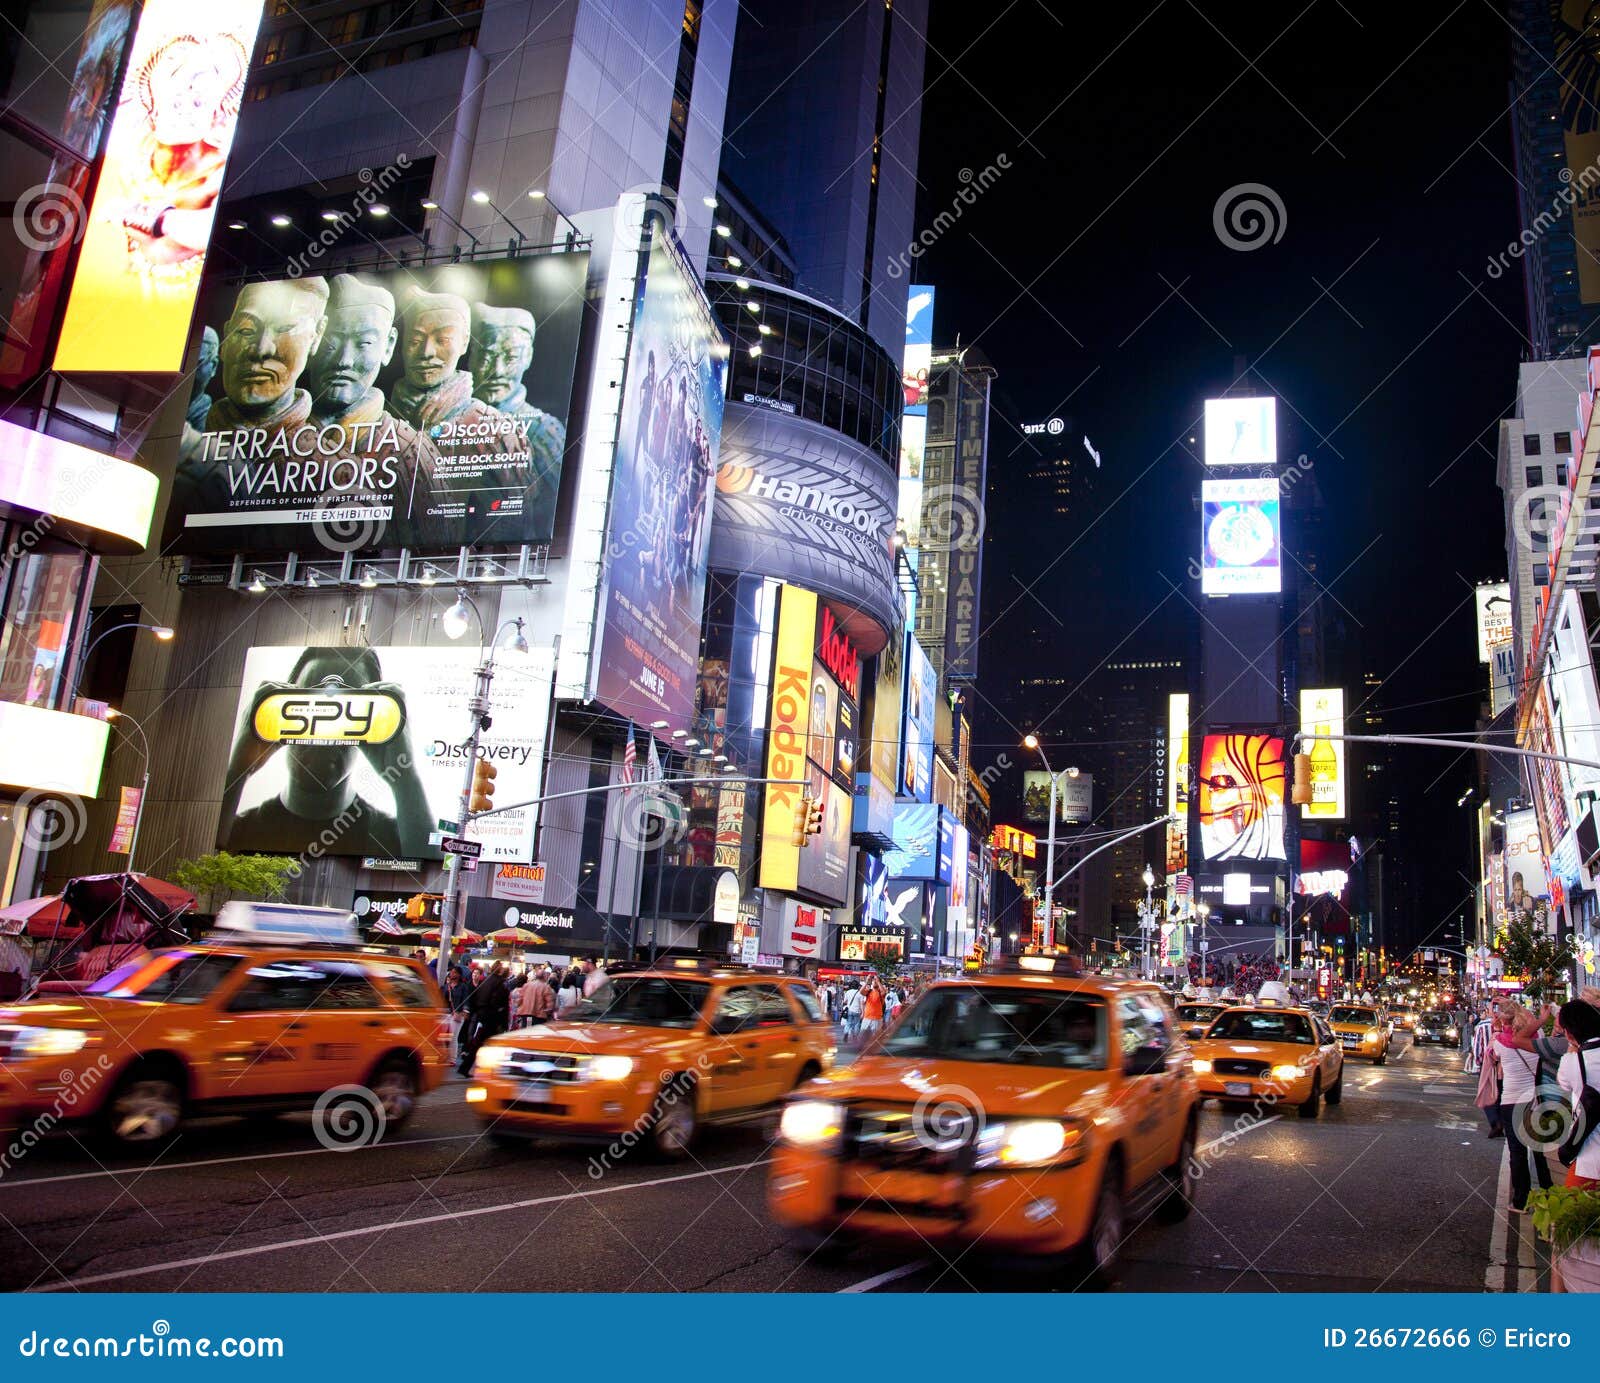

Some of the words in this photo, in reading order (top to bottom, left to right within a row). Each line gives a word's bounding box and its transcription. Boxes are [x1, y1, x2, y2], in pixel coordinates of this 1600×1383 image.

[438, 420, 532, 438] Discovery
[201, 420, 401, 462] TERRACOTTA
[437, 438, 460, 446] TIMES
[462, 436, 496, 446] SQUARE
[435, 456, 457, 465] ONE
[458, 454, 493, 464] BLOCK
[494, 451, 530, 463] SOUTH
[228, 456, 400, 496] WARRIORS
[229, 498, 277, 507] DEFENDERS
[292, 495, 324, 505] CHINA'S
[326, 495, 351, 503] FIRST
[353, 493, 395, 503] EMPEROR
[296, 511, 318, 521] THE
[321, 508, 391, 521] EXHIBITION
[779, 504, 833, 532] driving
[835, 524, 880, 553] emotion
[1484, 618, 1508, 627] BEST
[1485, 626, 1513, 639] THE
[820, 606, 860, 701] Kodak
[640, 666, 658, 693] JUNE
[657, 677, 665, 699] 15
[280, 700, 375, 737] SPY
[769, 665, 808, 811] Kodak
[1156, 739, 1166, 808] NOVOTEL
[503, 809, 526, 819] SOUTH
[494, 847, 521, 856] BASE
[498, 863, 545, 882] Marriott
[371, 898, 408, 916] sungla
[520, 911, 559, 929] sunglass
[558, 912, 574, 929] hut
[842, 926, 906, 935] MARQUIS
